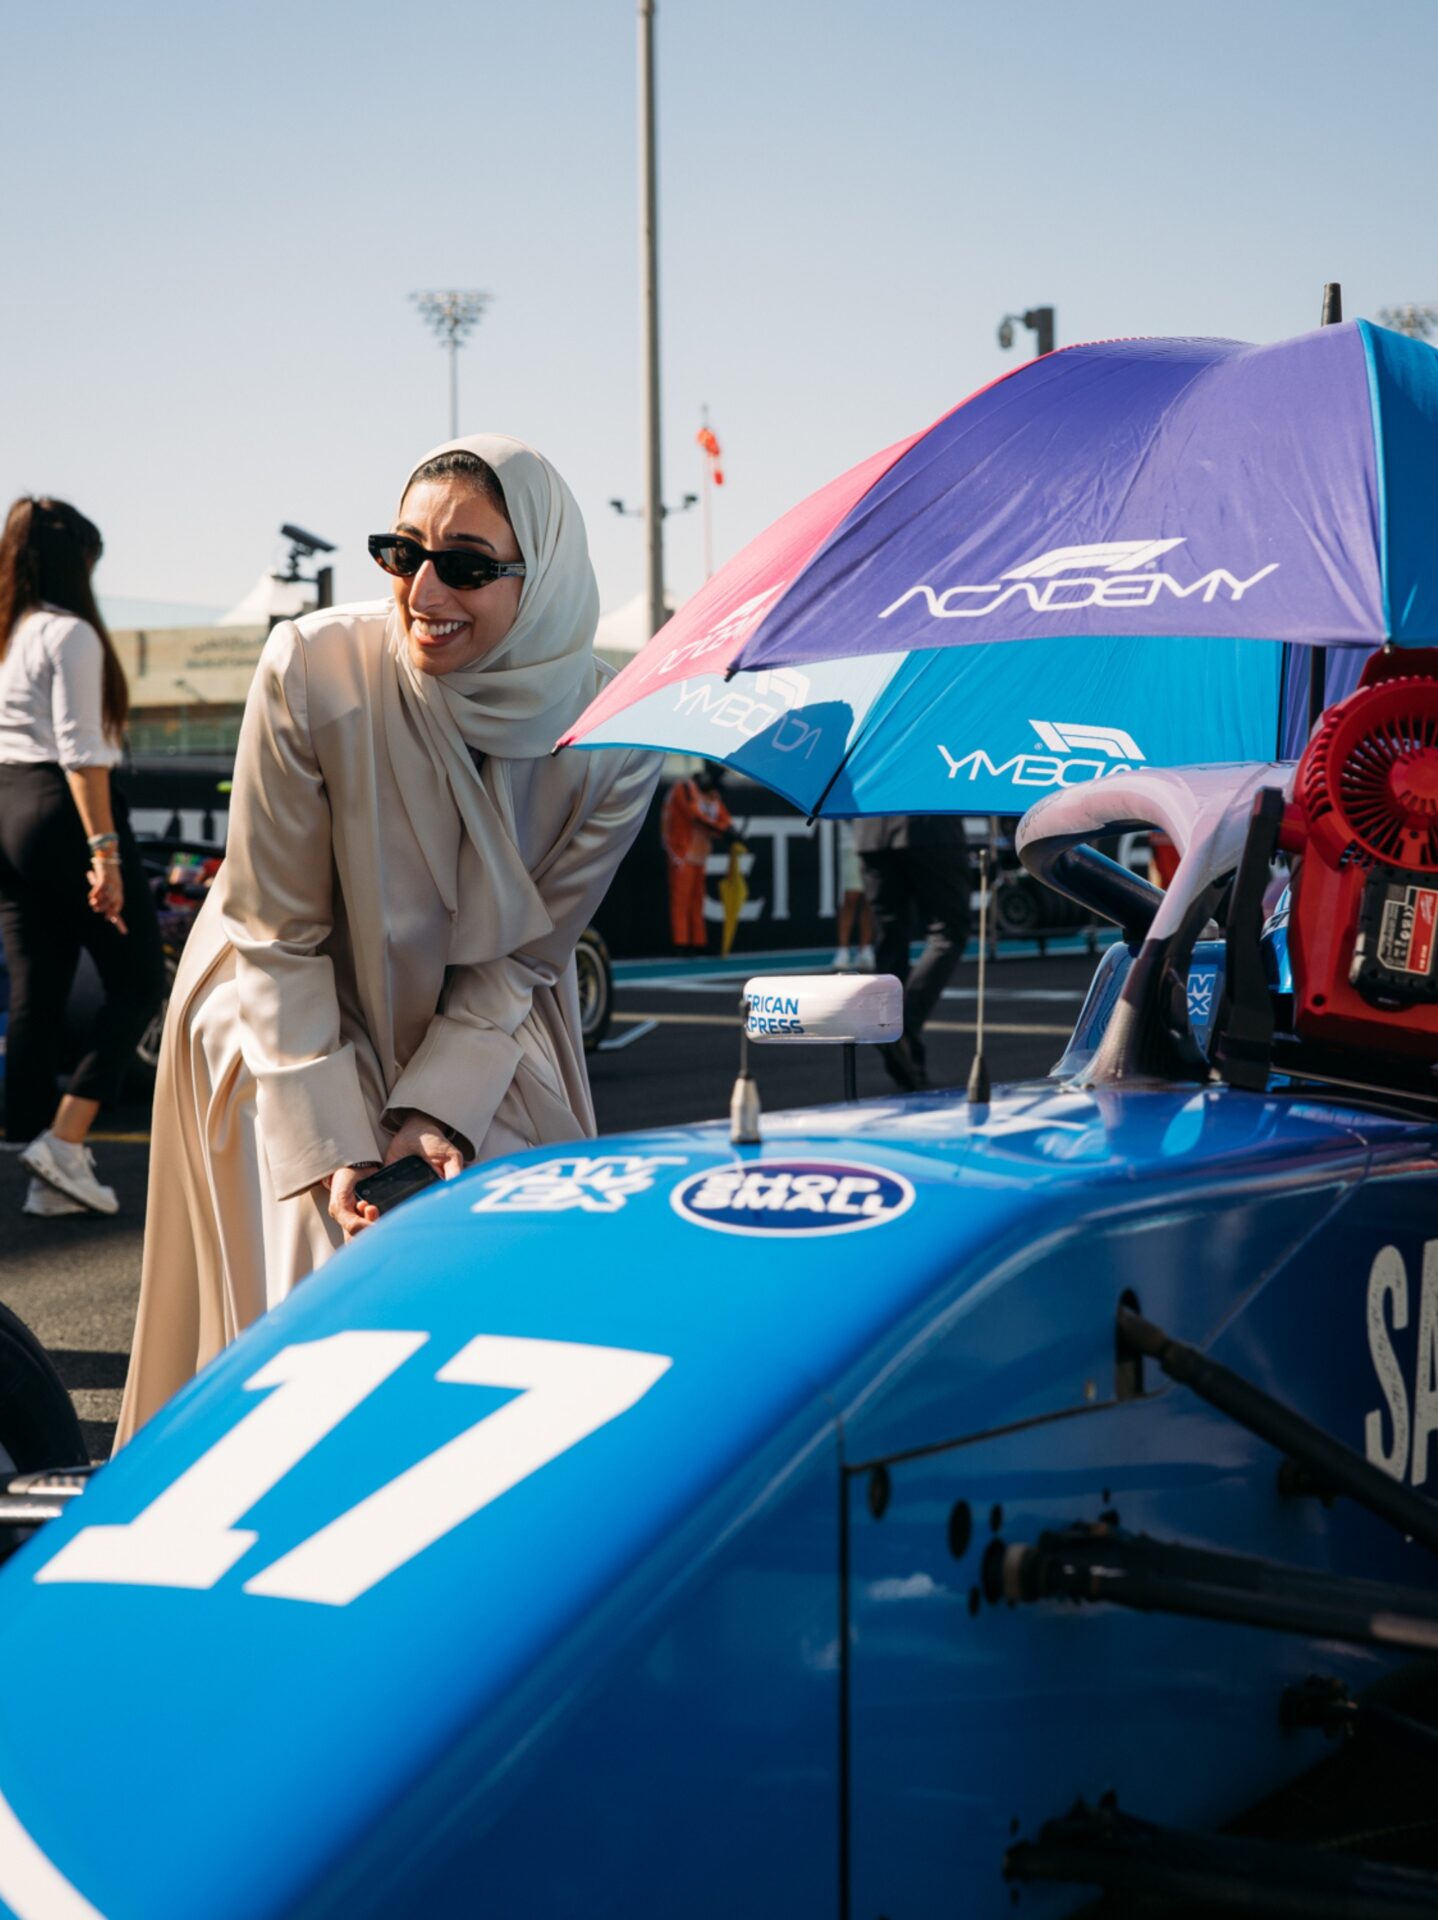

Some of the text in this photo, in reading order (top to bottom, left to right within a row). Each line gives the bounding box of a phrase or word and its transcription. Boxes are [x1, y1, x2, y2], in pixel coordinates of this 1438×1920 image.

[878, 563, 1280, 618] ACADEMY
[691, 1189, 896, 1217] SMALL
[703, 1173, 880, 1194] SHOP
[33, 1330, 673, 1607] 17
